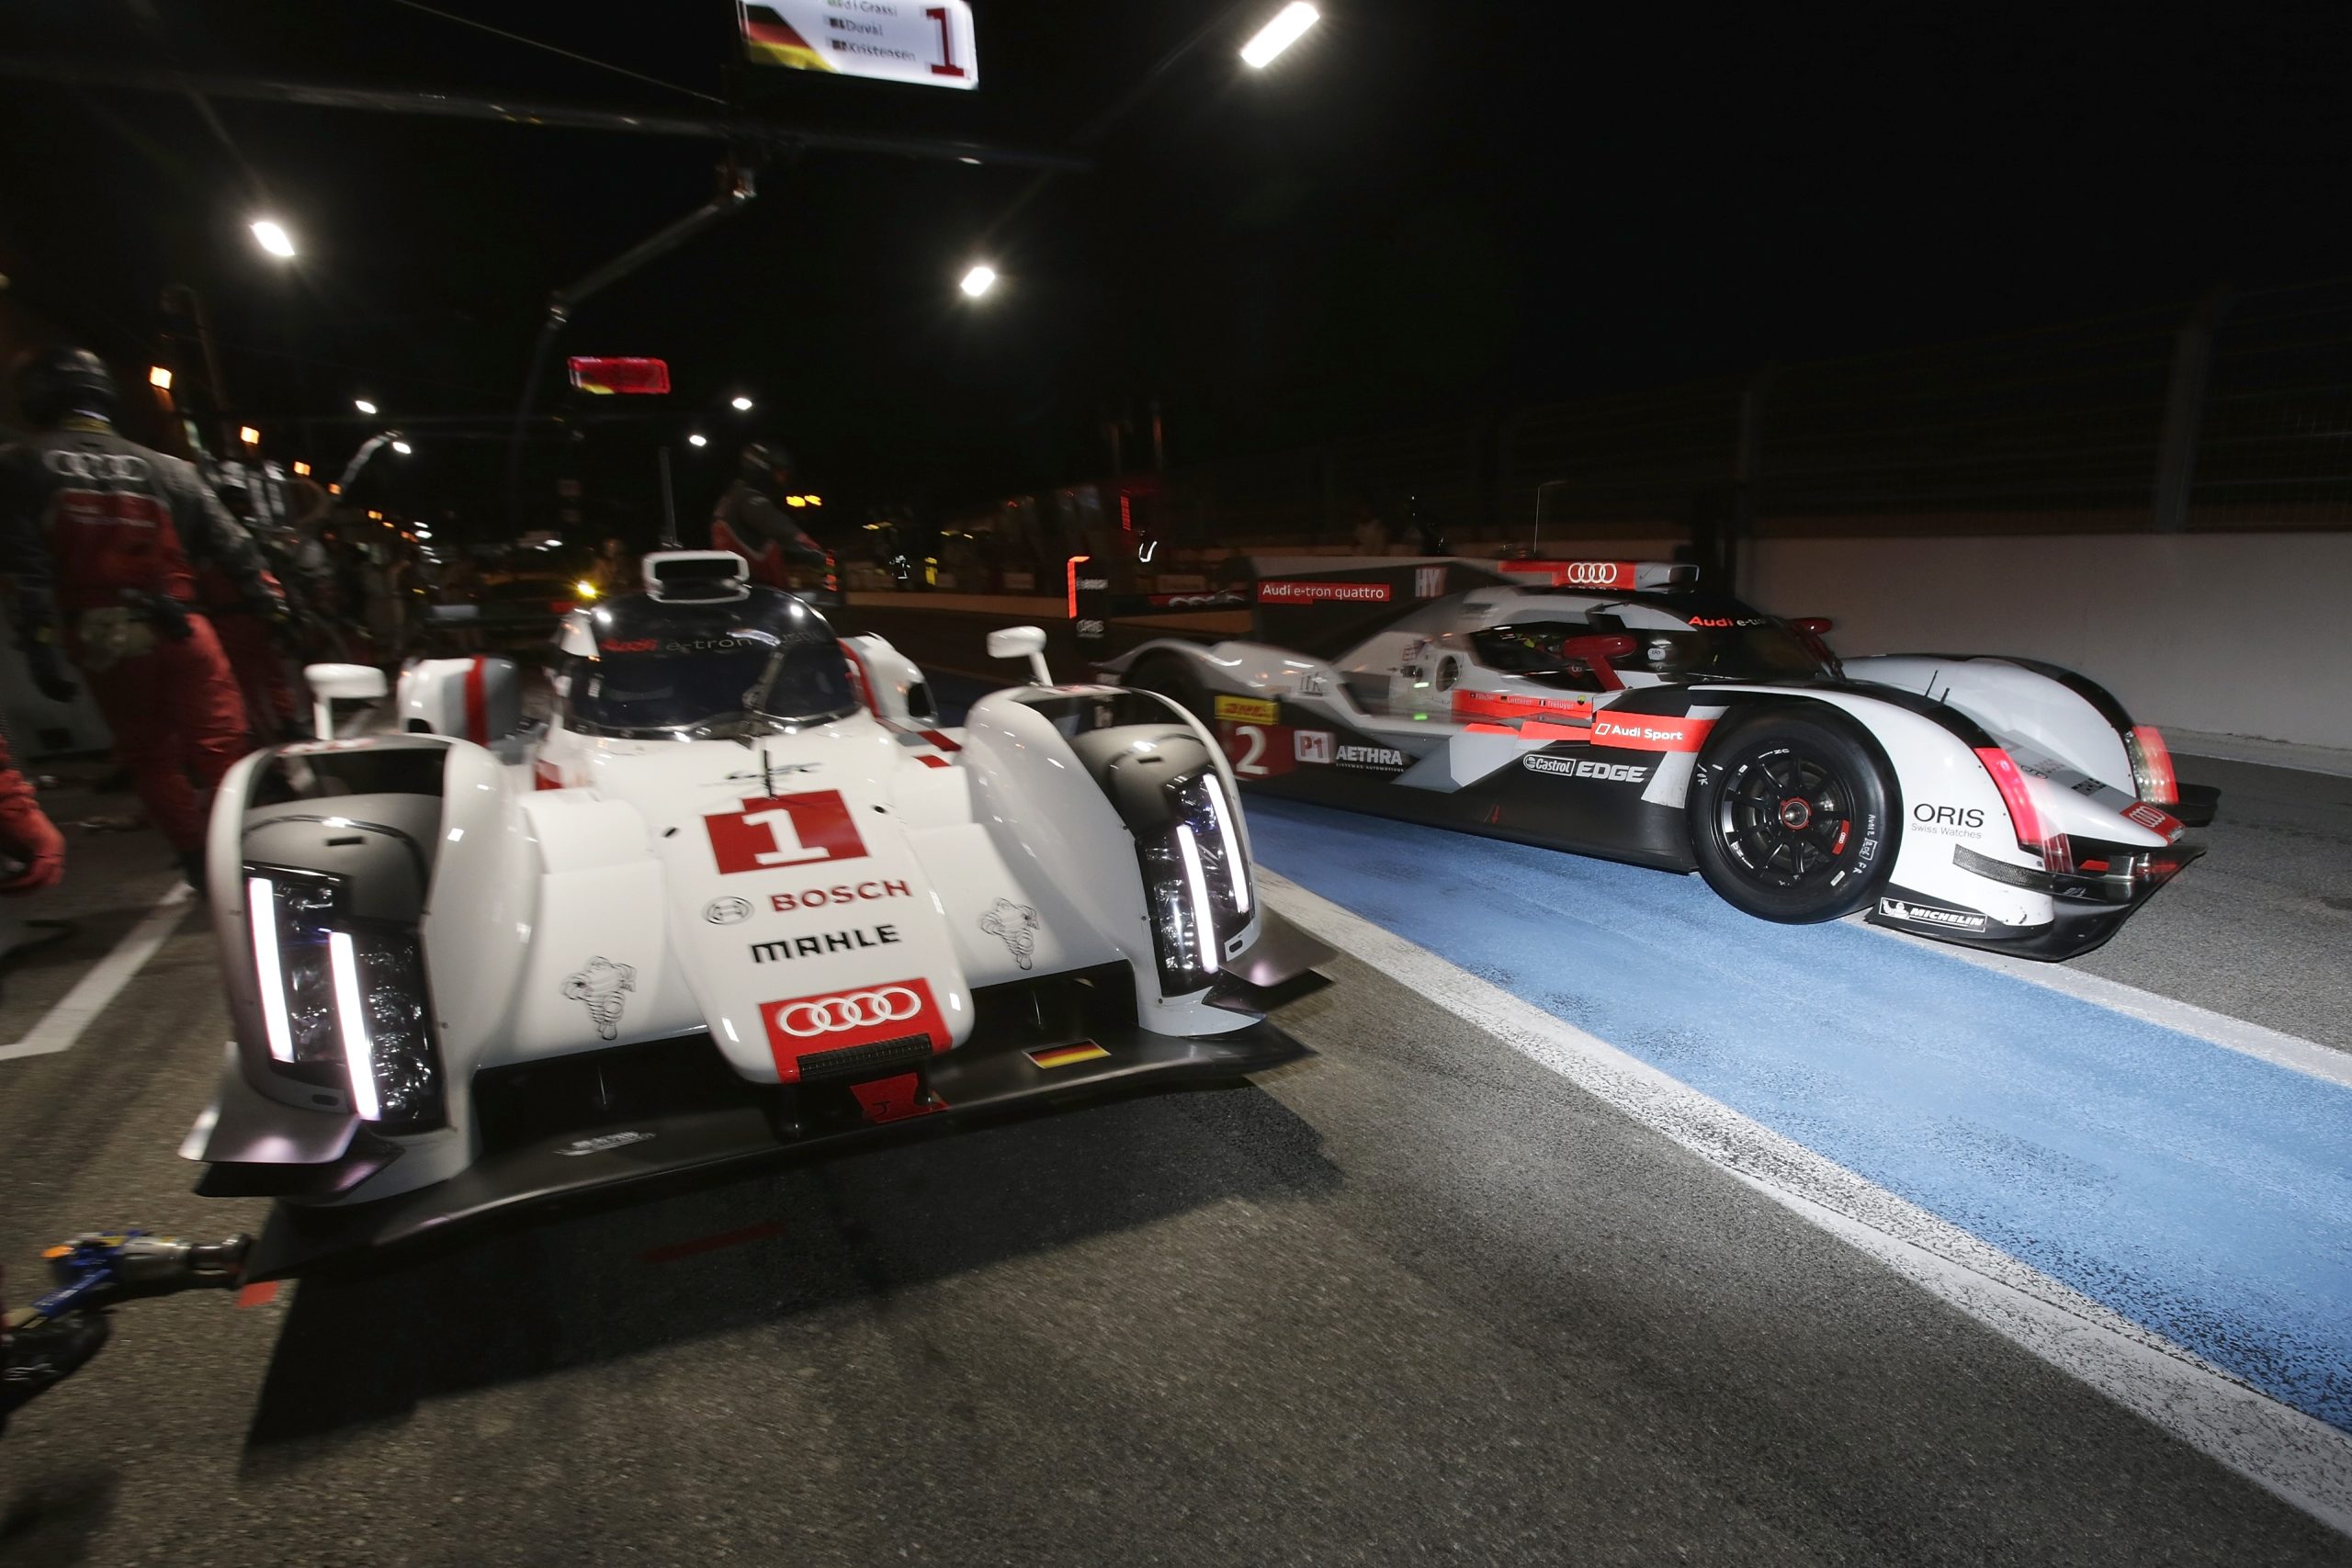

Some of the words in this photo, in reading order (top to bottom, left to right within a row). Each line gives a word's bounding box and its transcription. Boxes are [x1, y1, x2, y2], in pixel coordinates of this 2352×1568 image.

[861, 1, 897, 16] Grassi
[845, 18, 884, 36] Duval
[843, 40, 916, 62] Kristensen
[926, 7, 965, 77] 1
[1262, 584, 1291, 596] Audi
[1294, 585, 1331, 598] e-tron
[1335, 587, 1385, 601] quattro
[1688, 616, 1734, 626] Audi
[665, 635, 753, 653] e-tron
[1611, 725, 1641, 738] Audi
[1644, 729, 1683, 741] Sport
[1235, 726, 1271, 775] 2
[1300, 736, 1324, 760] P1
[1336, 745, 1404, 766] AETHRA
[1535, 757, 1571, 773] Castrol
[1576, 761, 1648, 784] EDGE
[1914, 803, 1984, 829] ORIS
[742, 808, 830, 865] 1
[1911, 822, 1938, 835] Swiss
[1940, 827, 1982, 840] Watches
[769, 879, 913, 912] BOSCH
[1910, 908, 1984, 926] MICHELIN
[750, 924, 902, 964] MAHLE
